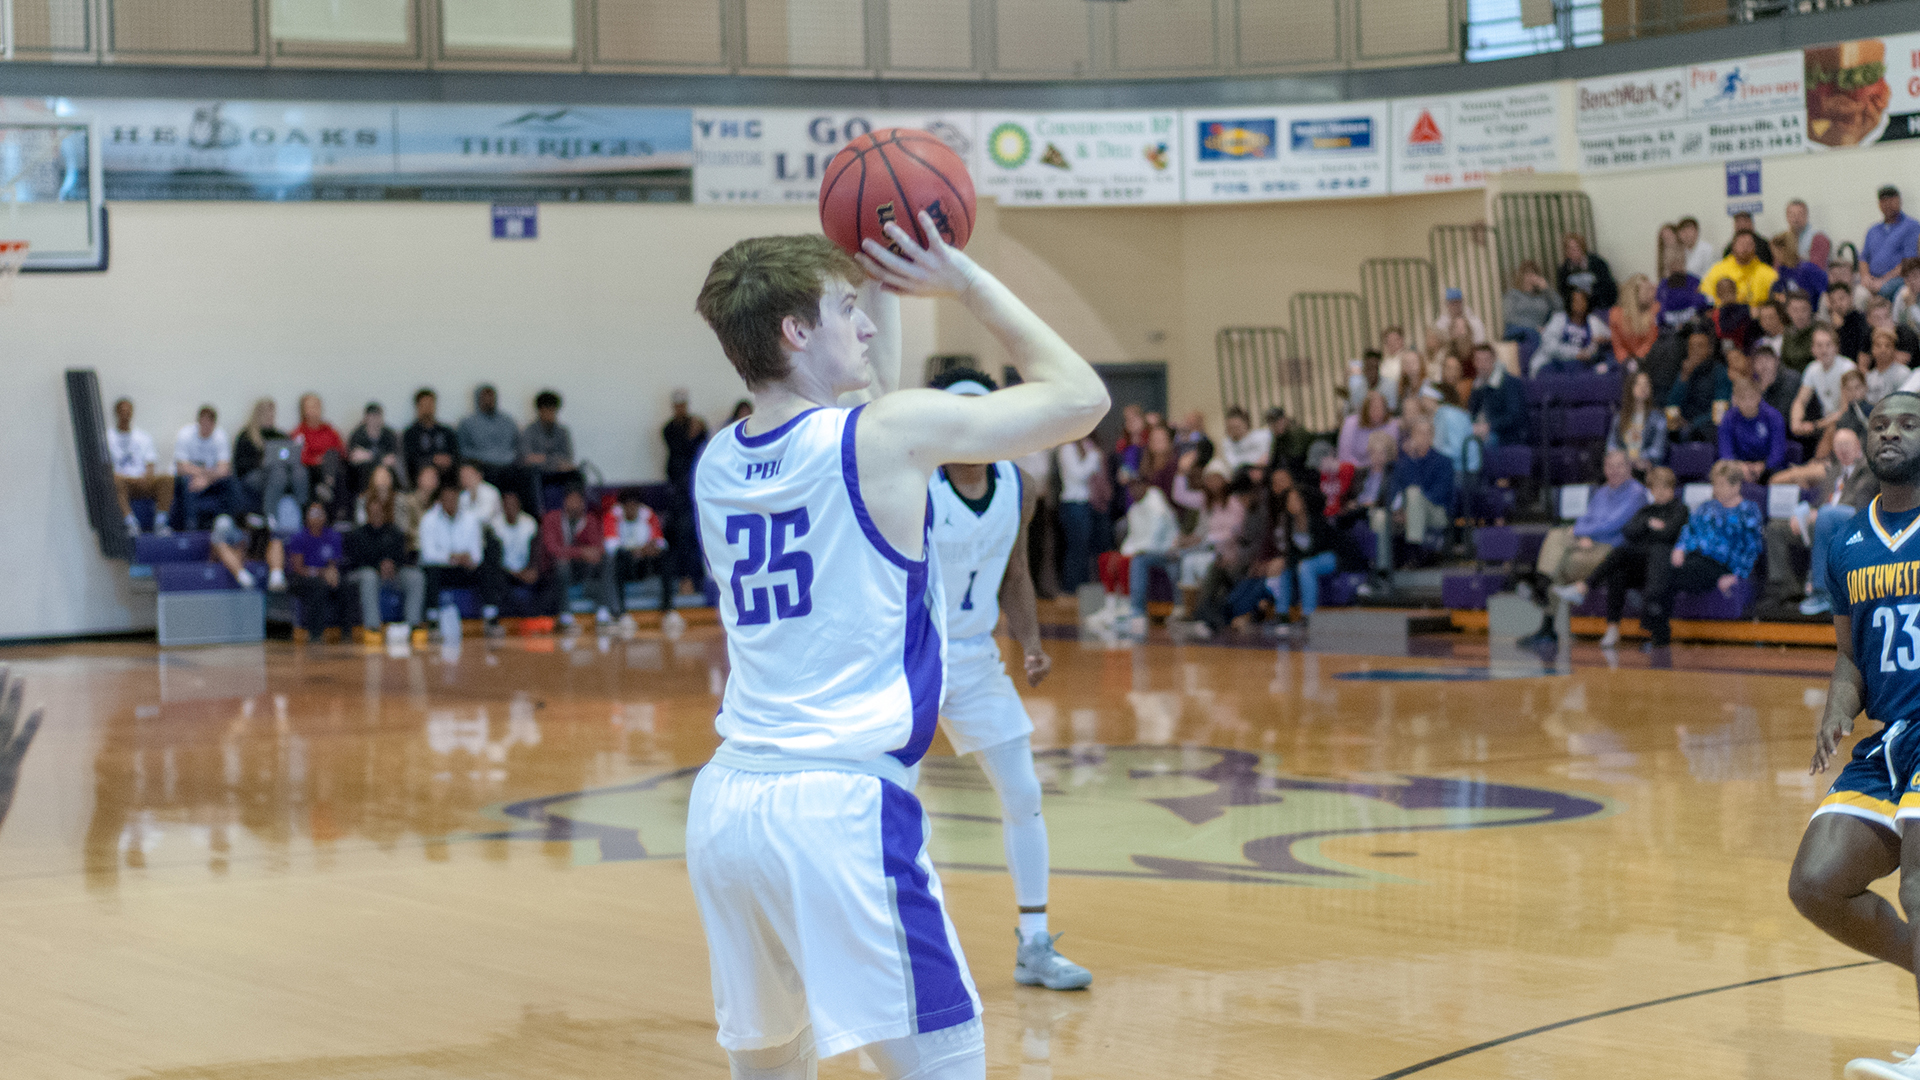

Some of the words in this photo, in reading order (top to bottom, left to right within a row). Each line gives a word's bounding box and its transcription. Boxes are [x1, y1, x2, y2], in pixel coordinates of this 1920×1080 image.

[112, 125, 176, 146] HE
[250, 125, 378, 146] OAKS
[808, 115, 873, 145] GO
[774, 152, 832, 180] LI
[725, 506, 814, 626] 25
[1847, 560, 1920, 605] SOUTHWEST
[961, 570, 979, 611] 1
[1872, 603, 1920, 673] 23
